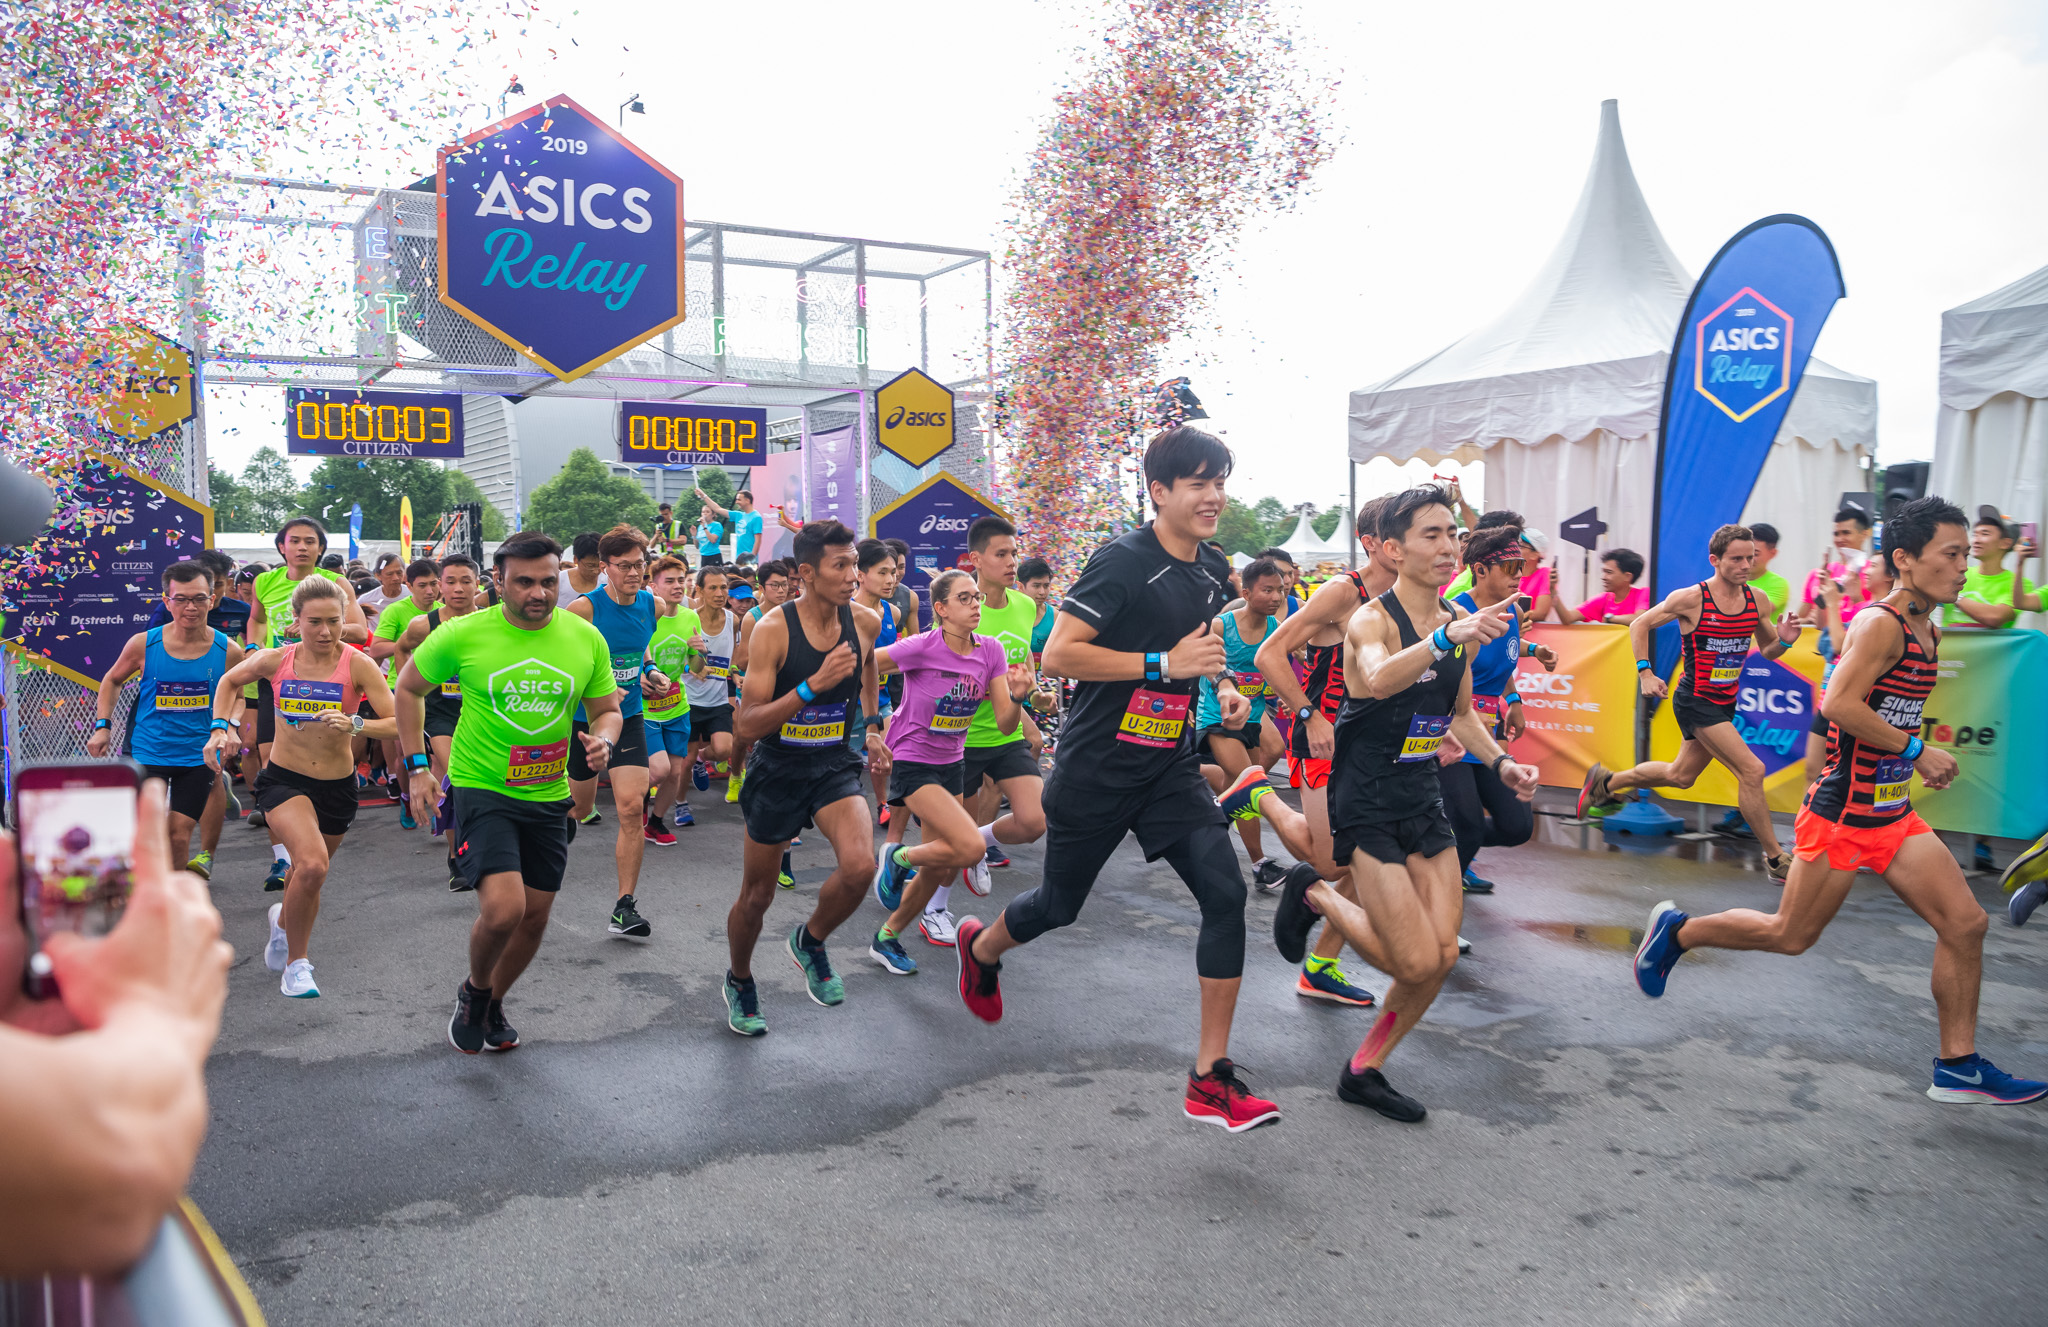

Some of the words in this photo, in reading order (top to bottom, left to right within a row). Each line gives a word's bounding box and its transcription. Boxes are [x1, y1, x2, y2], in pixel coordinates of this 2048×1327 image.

[541, 135, 588, 155] 2019
[474, 170, 653, 234] ASICS
[480, 227, 648, 311] Relay
[1708, 327, 1780, 352] ASICS
[1709, 354, 1776, 389] Relay
[905, 411, 947, 427] asics
[629, 415, 757, 453] 00:00:02
[343, 441, 413, 456] CITIZEN
[666, 451, 725, 465] CITIZEN
[111, 562, 153, 570] CITIZEN
[70, 614, 124, 626] Dr.stretch
[501, 680, 563, 695] ASICS
[160, 697, 206, 706] U-4103-1
[284, 701, 337, 712] F-4084-1
[505, 695, 558, 717] Relay
[1572, 702, 1602, 712] ME
[1735, 687, 1805, 715] SICS
[786, 725, 839, 738] M-4038-1
[1128, 716, 1179, 735] U-2118-1
[512, 760, 563, 777] U-2227-1
